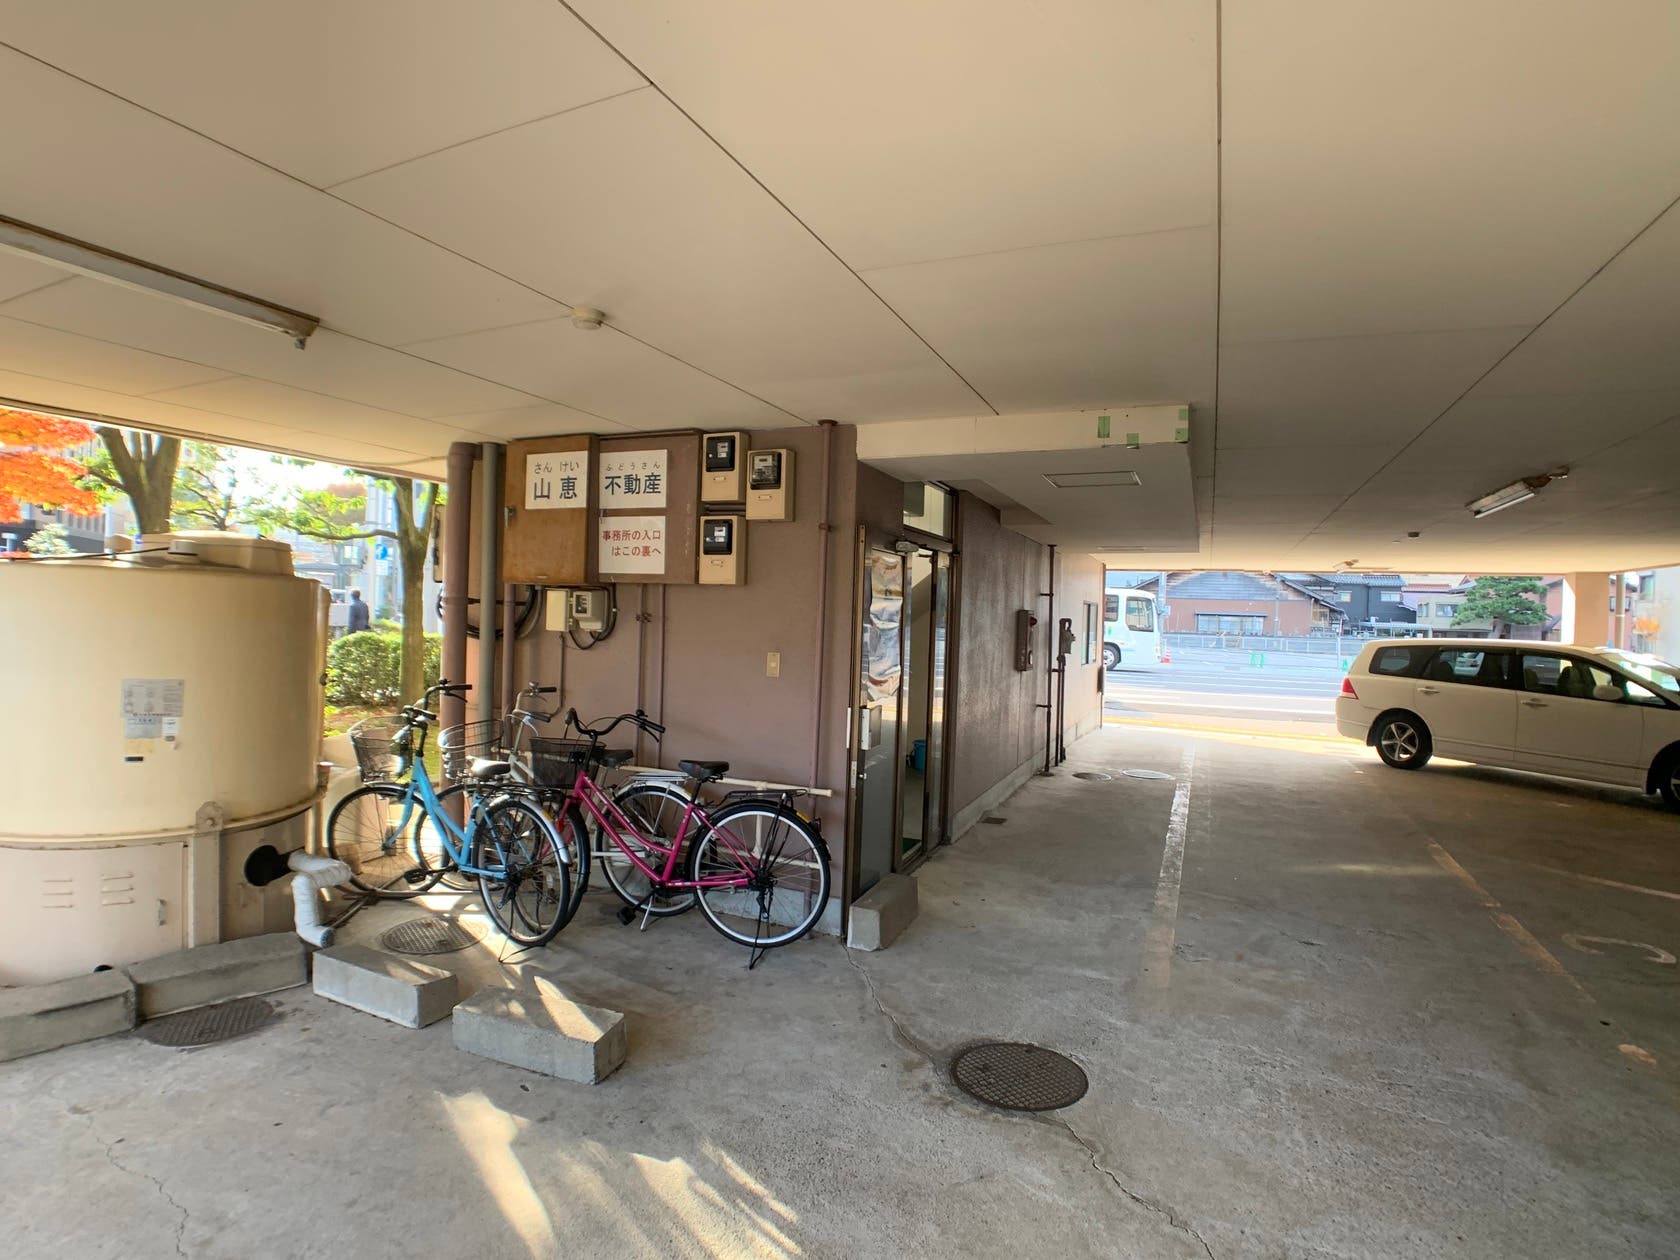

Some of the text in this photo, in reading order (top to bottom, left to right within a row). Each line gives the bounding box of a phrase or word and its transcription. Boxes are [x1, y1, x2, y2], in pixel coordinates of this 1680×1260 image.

[606, 461, 660, 472] ふどうさん
[604, 472, 662, 496] 不動産
[602, 529, 661, 541] 事務所の入口
[611, 545, 661, 557] はこの裏へ
